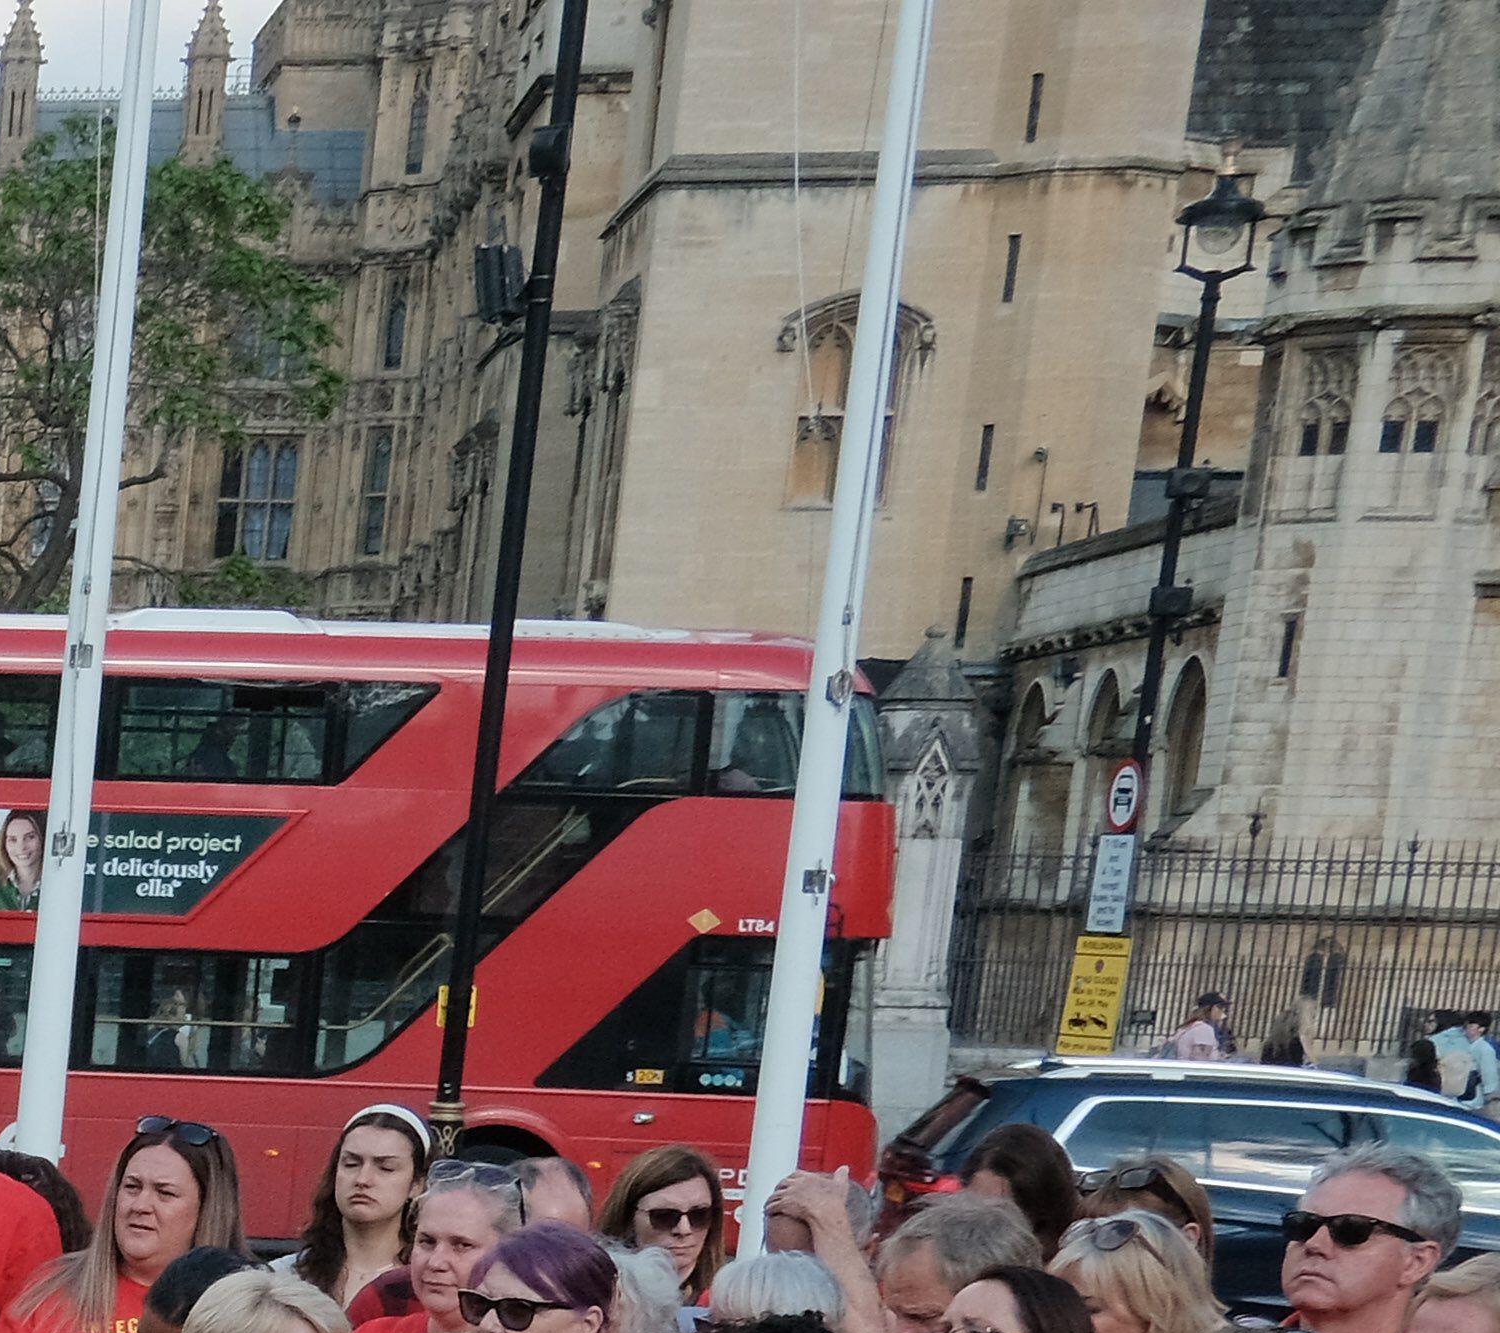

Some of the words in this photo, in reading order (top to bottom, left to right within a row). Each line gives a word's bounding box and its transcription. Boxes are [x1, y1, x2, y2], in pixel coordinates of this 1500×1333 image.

[103, 830, 163, 851] salad
[167, 834, 243, 856] project
[102, 858, 220, 884] deliciously
[136, 879, 176, 899] ella
